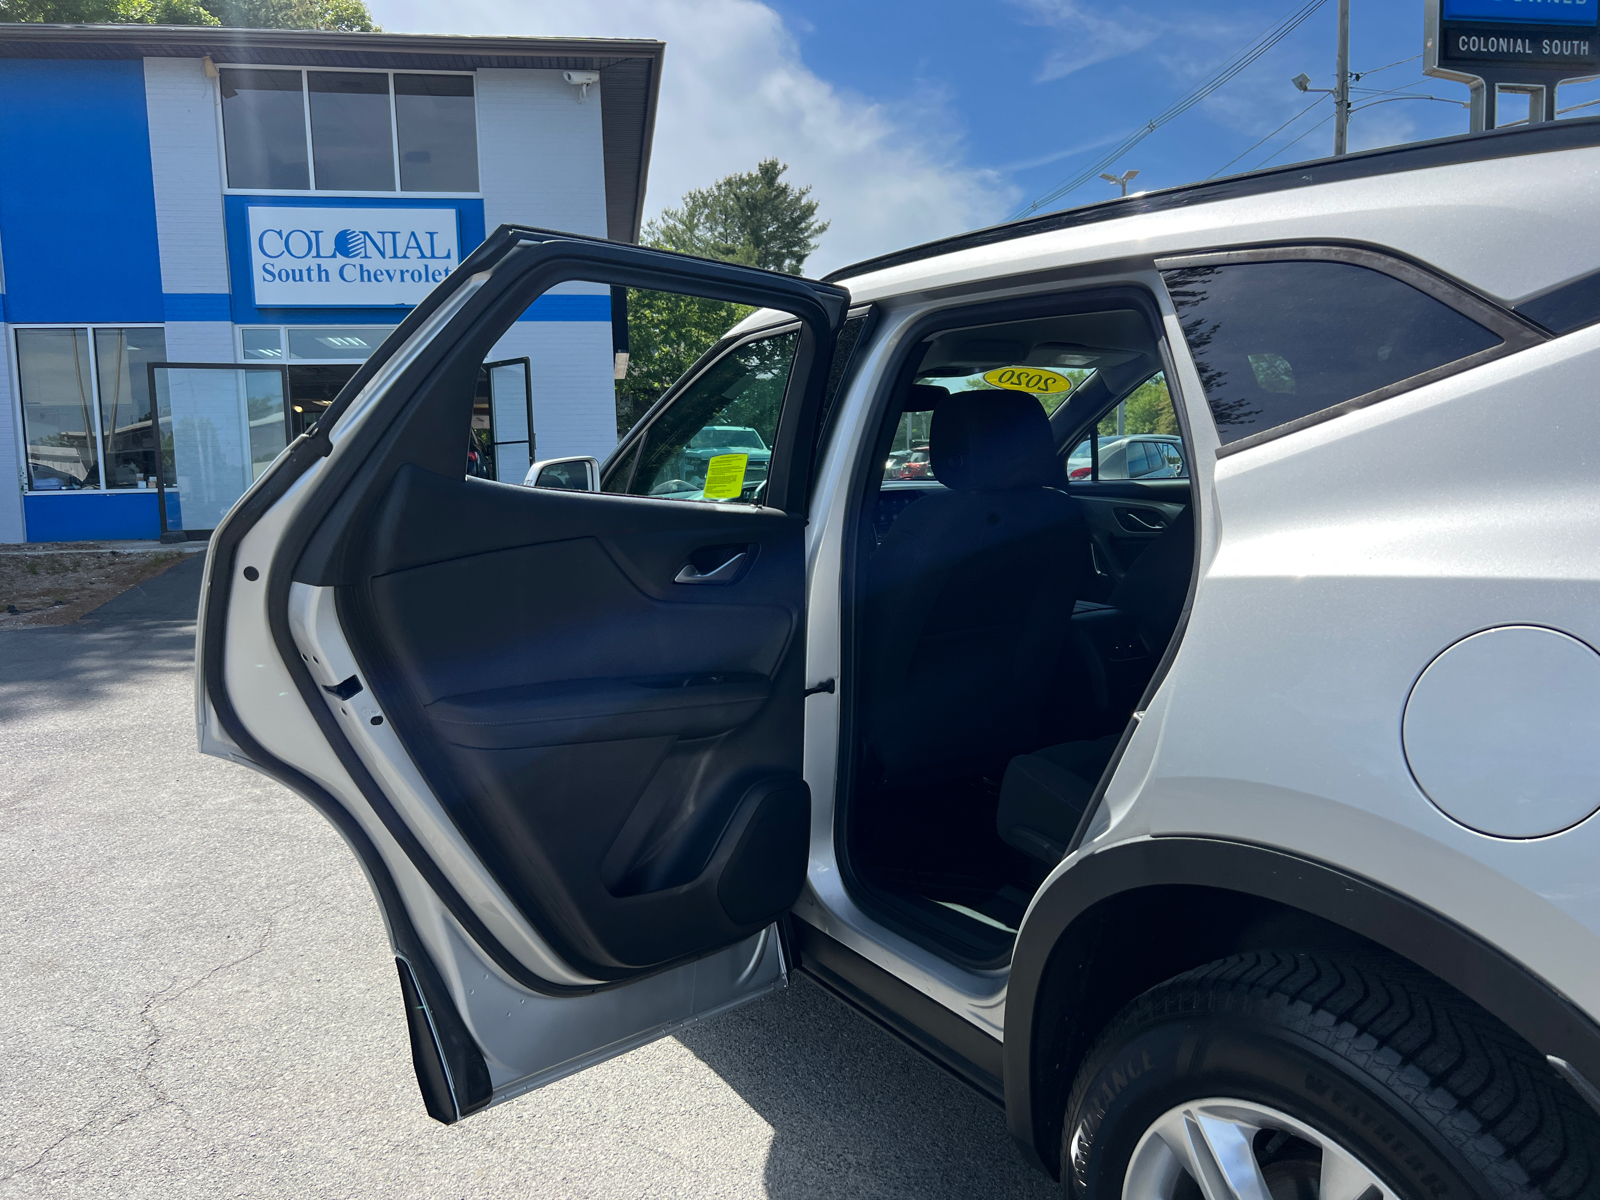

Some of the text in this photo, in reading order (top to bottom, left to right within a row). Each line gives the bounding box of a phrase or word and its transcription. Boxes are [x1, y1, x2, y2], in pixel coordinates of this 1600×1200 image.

[1459, 35, 1589, 56] COLONIAL SOUTH
[258, 228, 452, 260] COLONIAL
[261, 262, 452, 284] South Chevrolet
